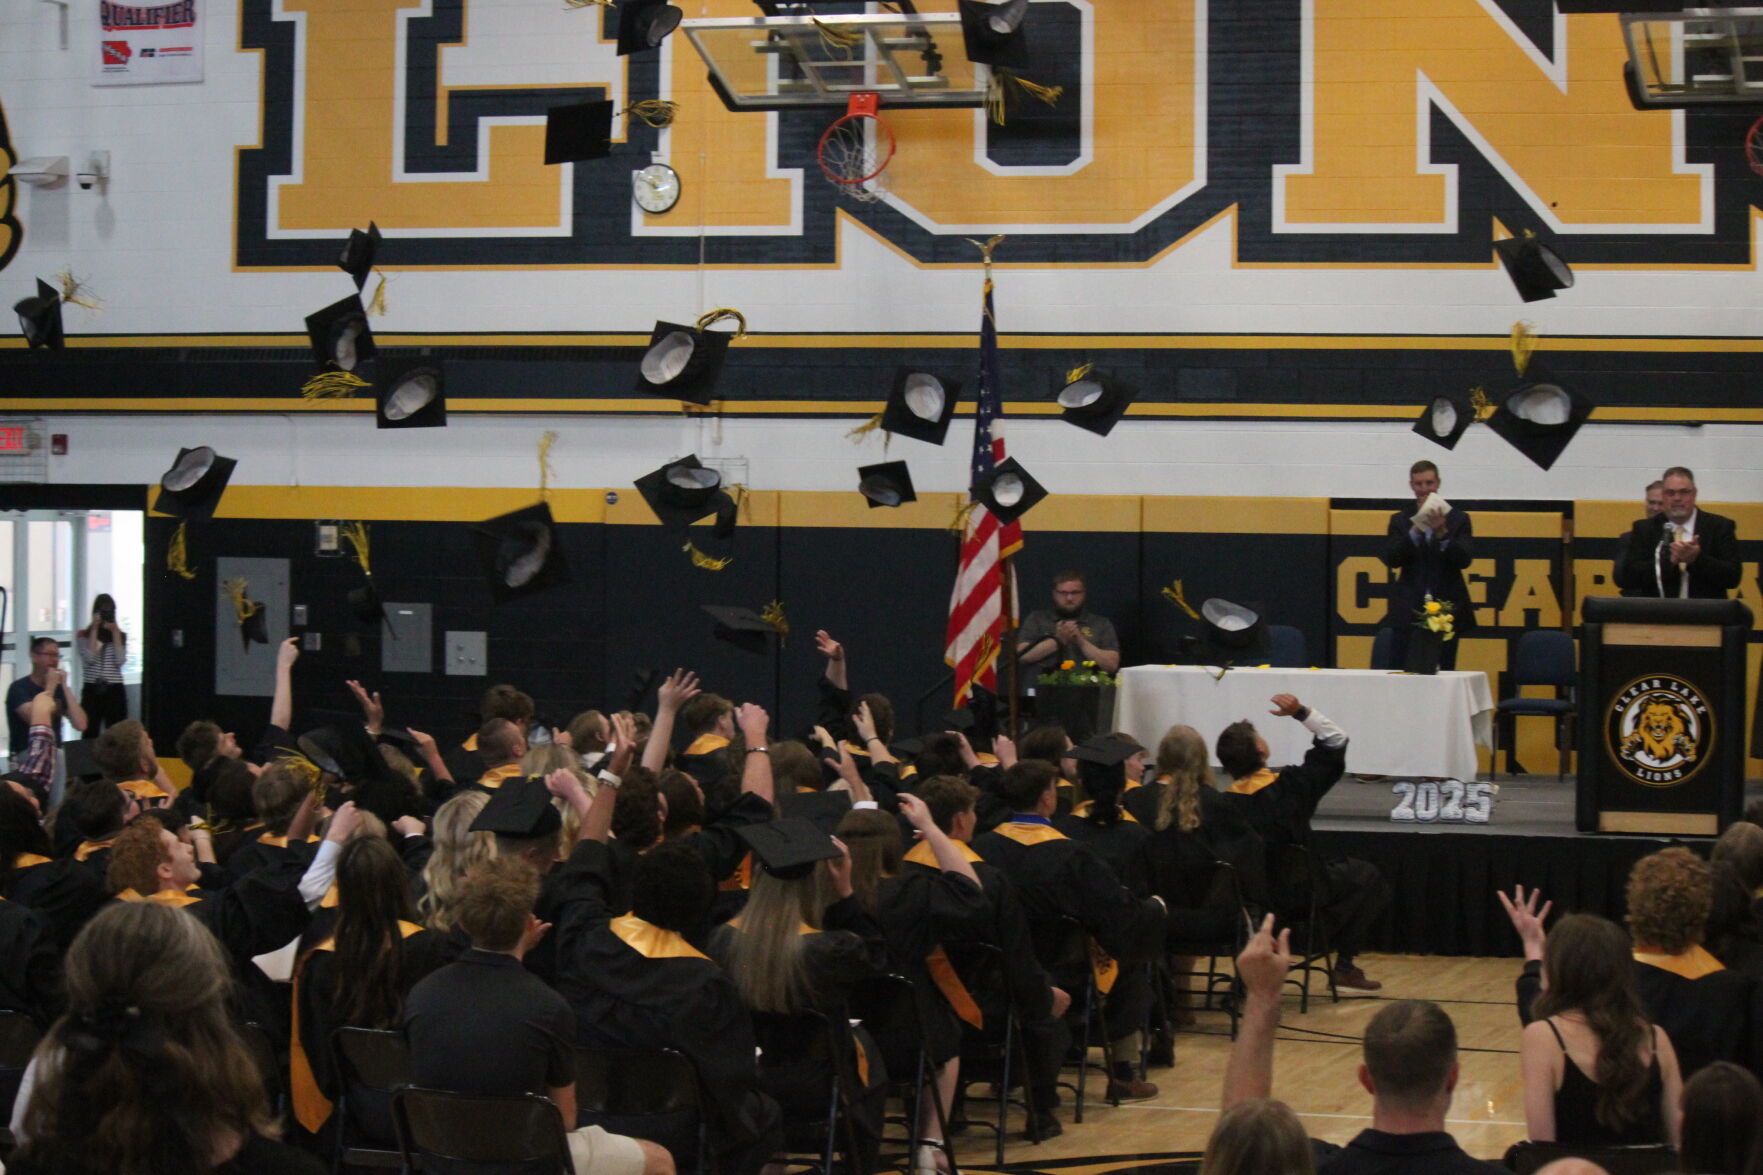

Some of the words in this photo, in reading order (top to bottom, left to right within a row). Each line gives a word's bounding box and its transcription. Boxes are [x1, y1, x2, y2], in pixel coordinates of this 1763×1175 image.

[101, 0, 195, 27] QUALIFIER
[1336, 556, 1624, 628] CEAR
[1614, 679, 1661, 712] CLEAR
[1670, 681, 1706, 714] LAKE
[1635, 767, 1683, 781] LIONS
[1390, 780, 1499, 824] 2025
